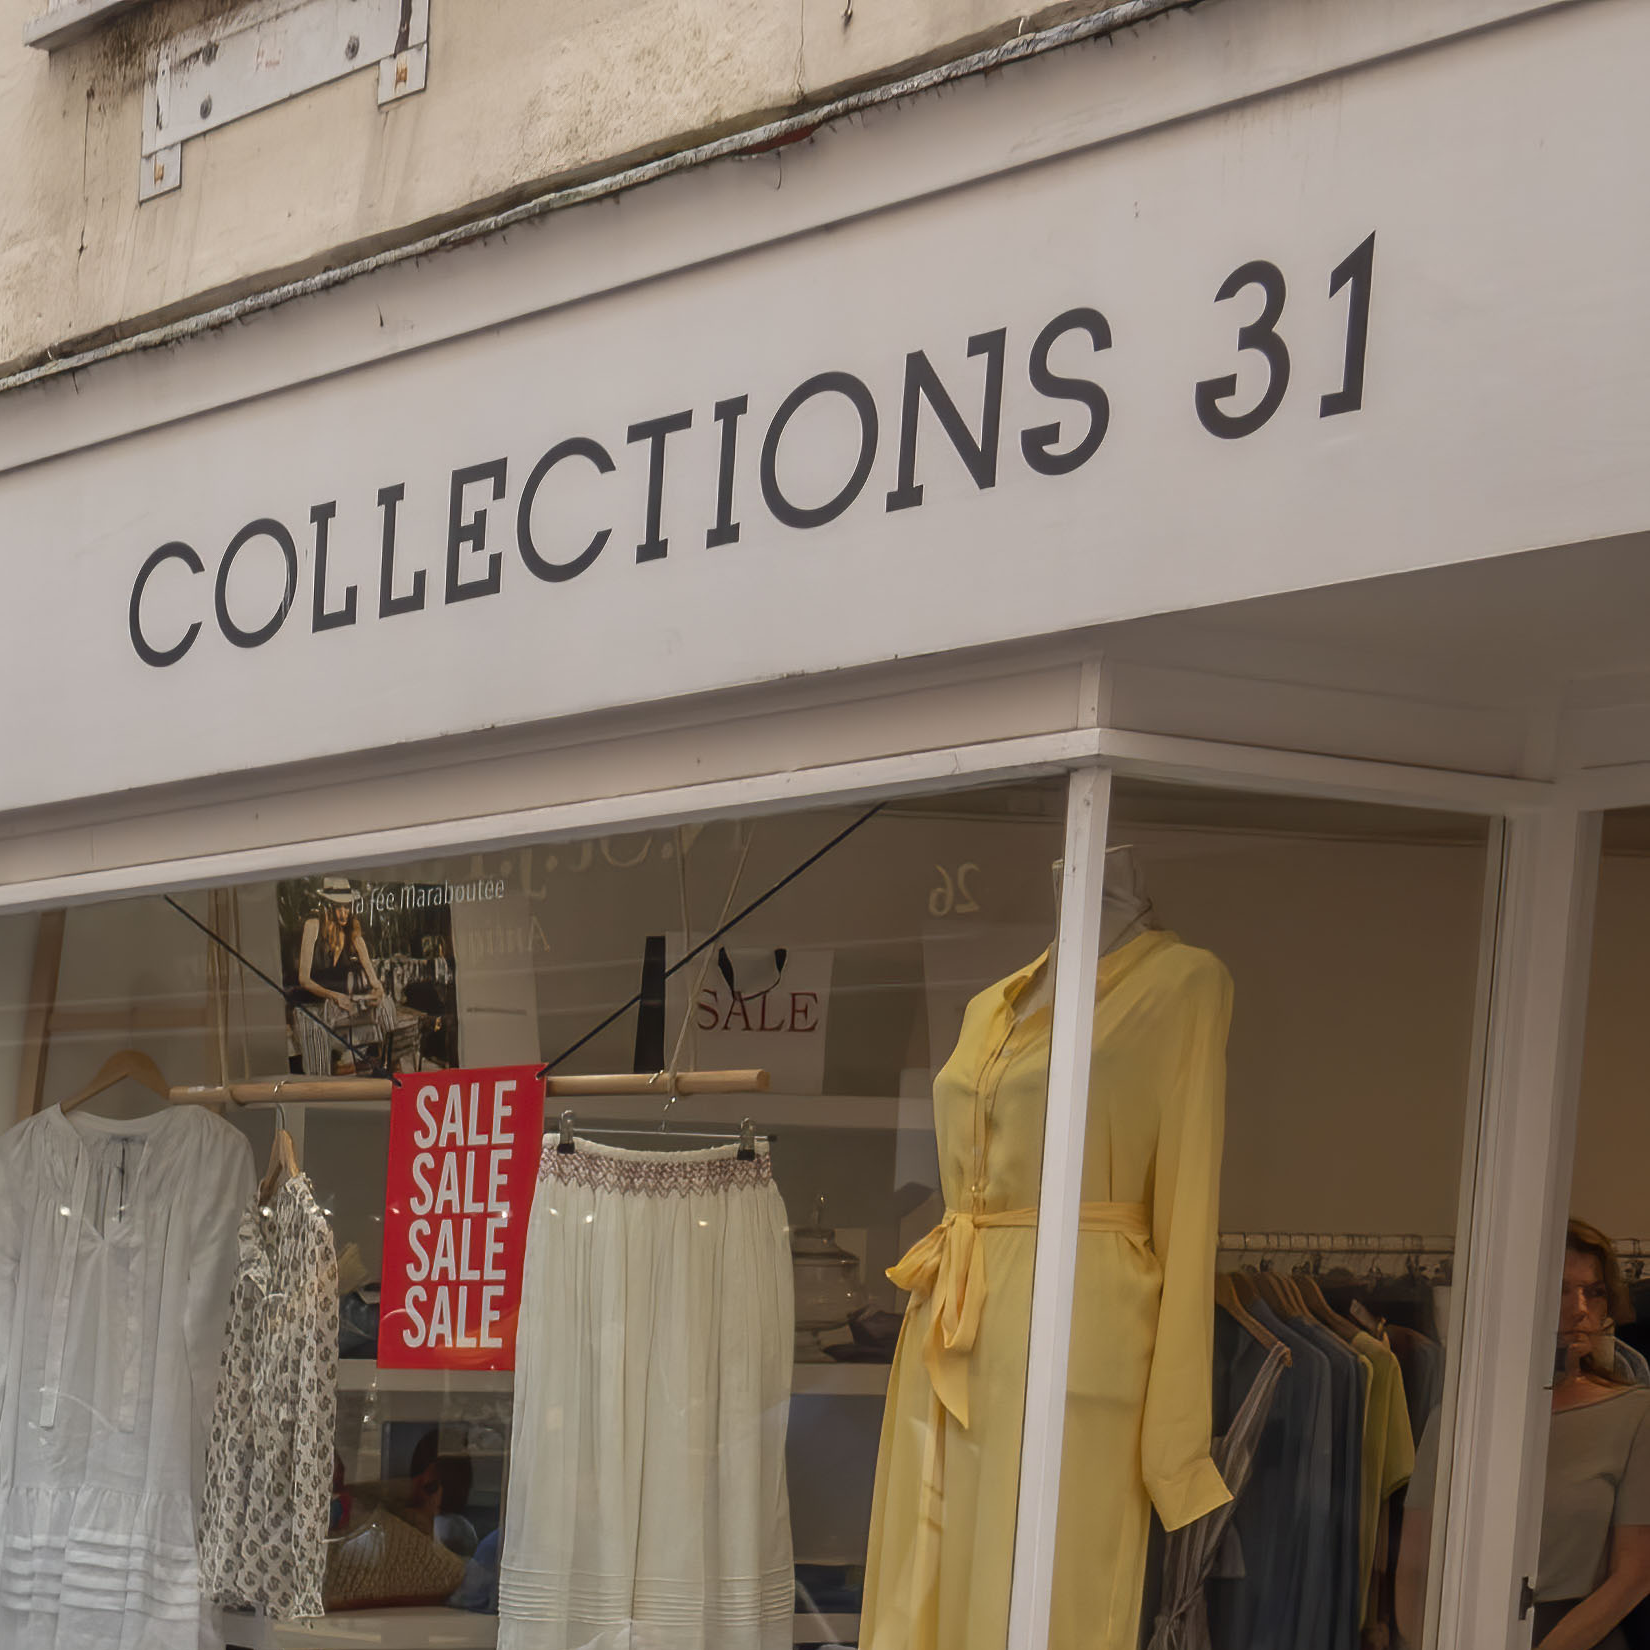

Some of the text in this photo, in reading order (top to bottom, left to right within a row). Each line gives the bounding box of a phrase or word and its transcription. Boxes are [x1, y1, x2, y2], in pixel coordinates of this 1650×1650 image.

[127, 231, 1377, 668] COLLECTIONS 31
[696, 989, 820, 1035] SALE
[413, 1079, 517, 1148] SALE
[410, 1148, 513, 1214] SALE
[406, 1218, 508, 1282] SALE
[402, 1285, 504, 1350] SALE
